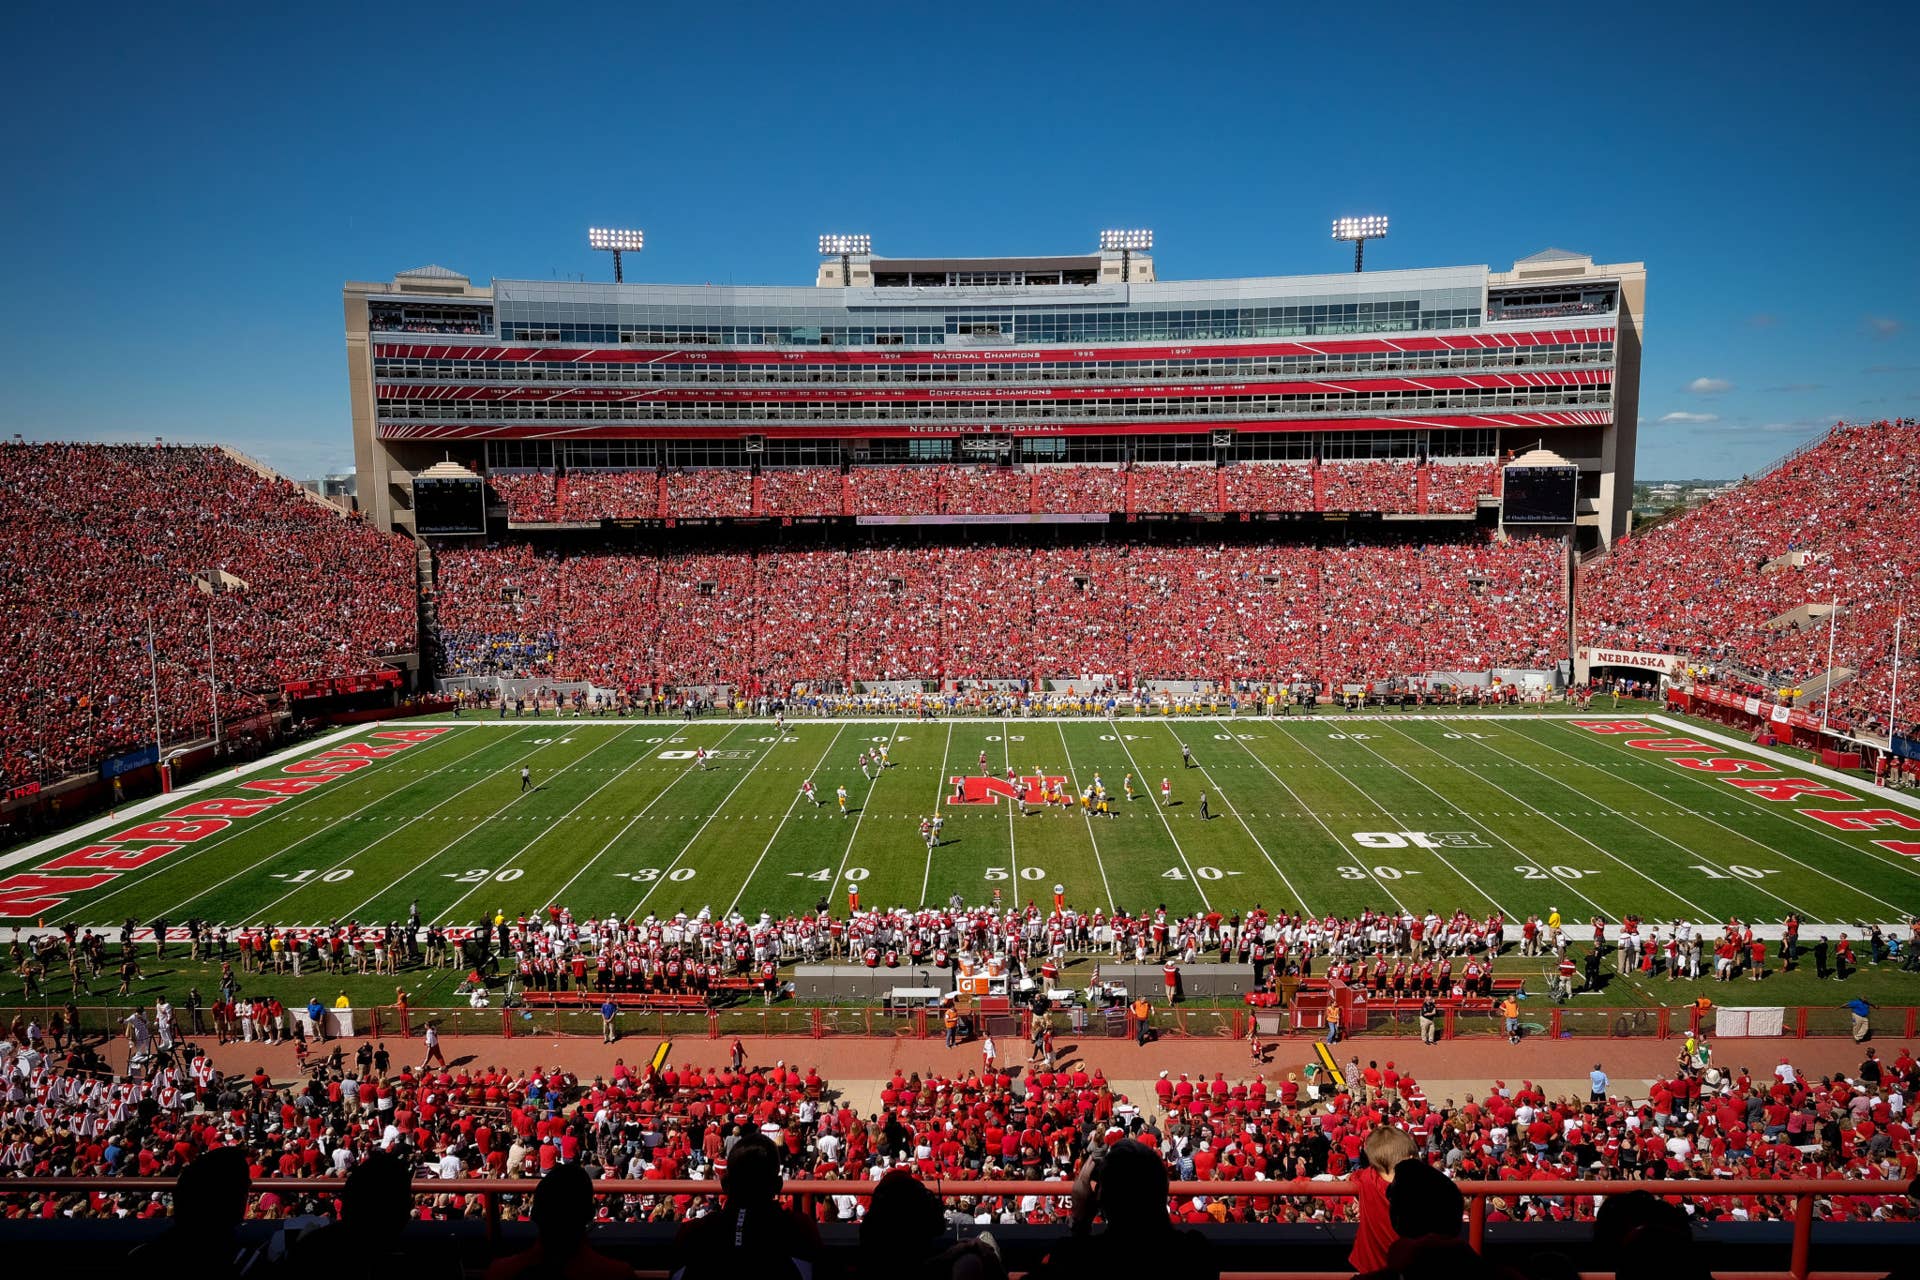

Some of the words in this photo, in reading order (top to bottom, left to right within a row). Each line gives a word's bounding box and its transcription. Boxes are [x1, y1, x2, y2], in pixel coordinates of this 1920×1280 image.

[1579, 651, 1587, 660] N
[1598, 652, 1666, 667] NEBRASKA
[1676, 660, 1686, 669] N
[947, 776, 1074, 805] N
[0, 727, 454, 918] NEBRASKA
[961, 979, 972, 991] G
[1058, 1196, 1072, 1208] 75
